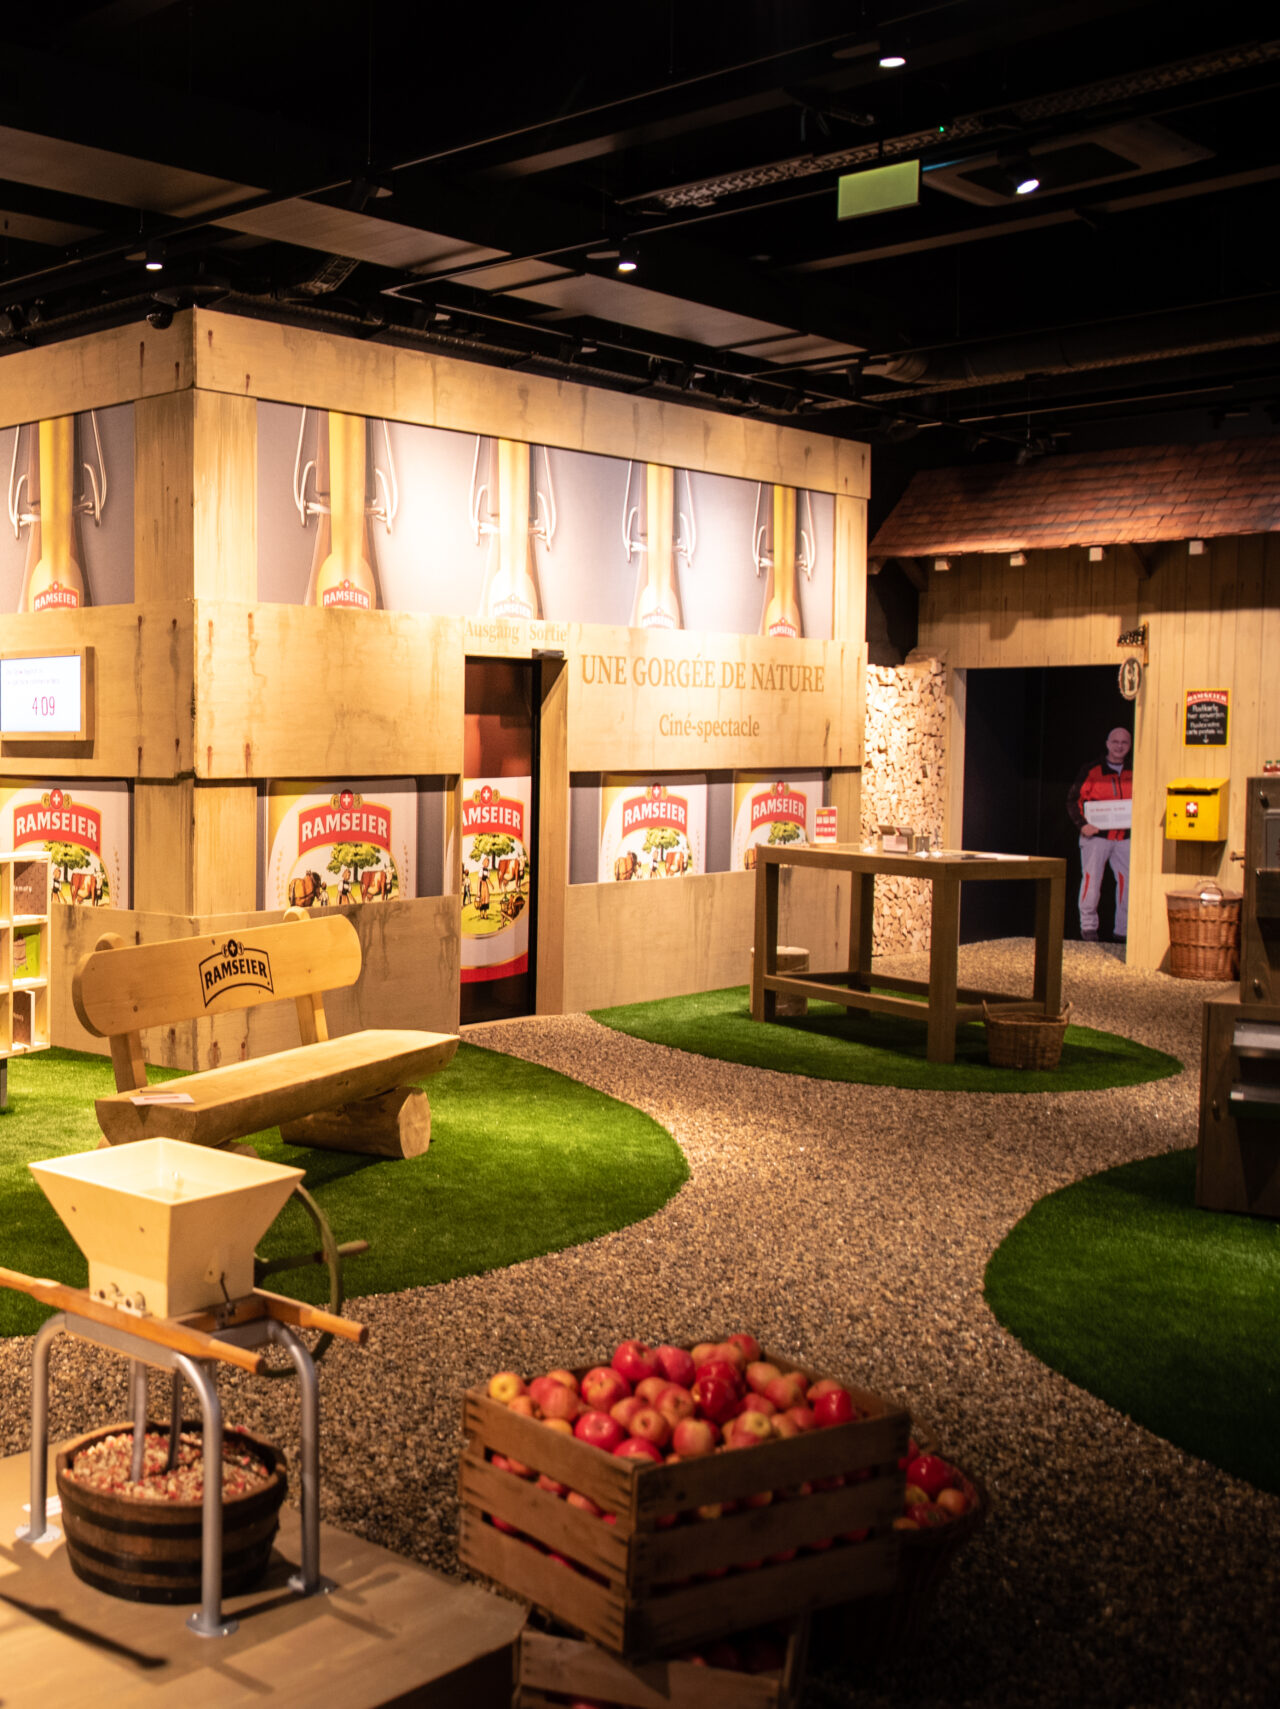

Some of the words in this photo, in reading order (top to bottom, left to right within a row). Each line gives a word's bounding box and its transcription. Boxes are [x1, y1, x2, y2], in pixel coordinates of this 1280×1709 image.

[34, 592, 78, 609] RAMSEIER
[323, 590, 369, 607] RAMSEIER
[529, 623, 568, 642] Sortie
[581, 654, 627, 685] UNE
[632, 653, 716, 688] GORGÉE
[720, 661, 746, 689] DE
[751, 663, 825, 692] NATURE
[659, 712, 760, 743] Ciné-spectacle
[624, 801, 685, 827] RAMSEIER
[752, 797, 805, 820] RAMSEIER
[16, 810, 98, 842] RAMSEIER
[301, 811, 388, 843] RAMSEIER
[204, 958, 268, 991] RAMSEIER
